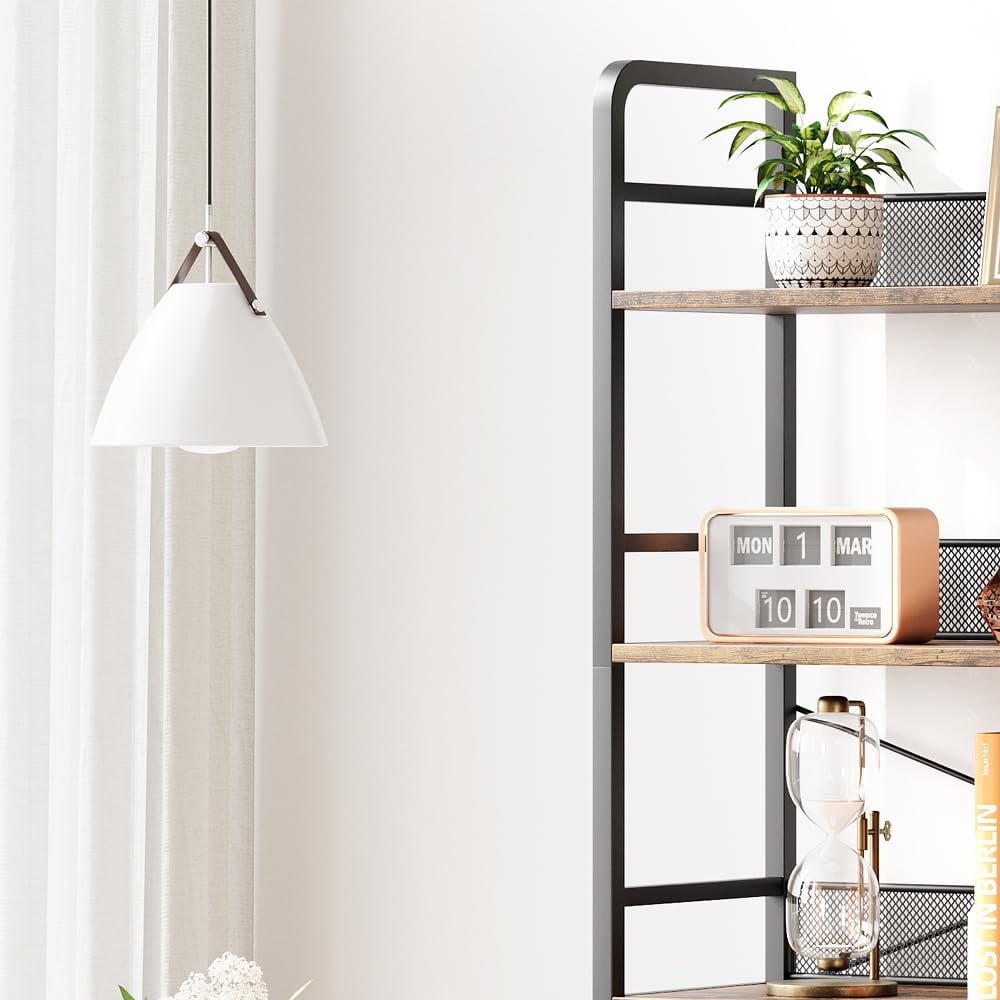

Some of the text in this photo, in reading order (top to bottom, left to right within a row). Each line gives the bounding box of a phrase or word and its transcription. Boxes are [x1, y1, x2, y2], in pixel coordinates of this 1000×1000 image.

[736, 531, 872, 560] MON 1 MAR
[763, 596, 841, 624] 10 10
[976, 804, 998, 1000] LOST IN BERLIN
